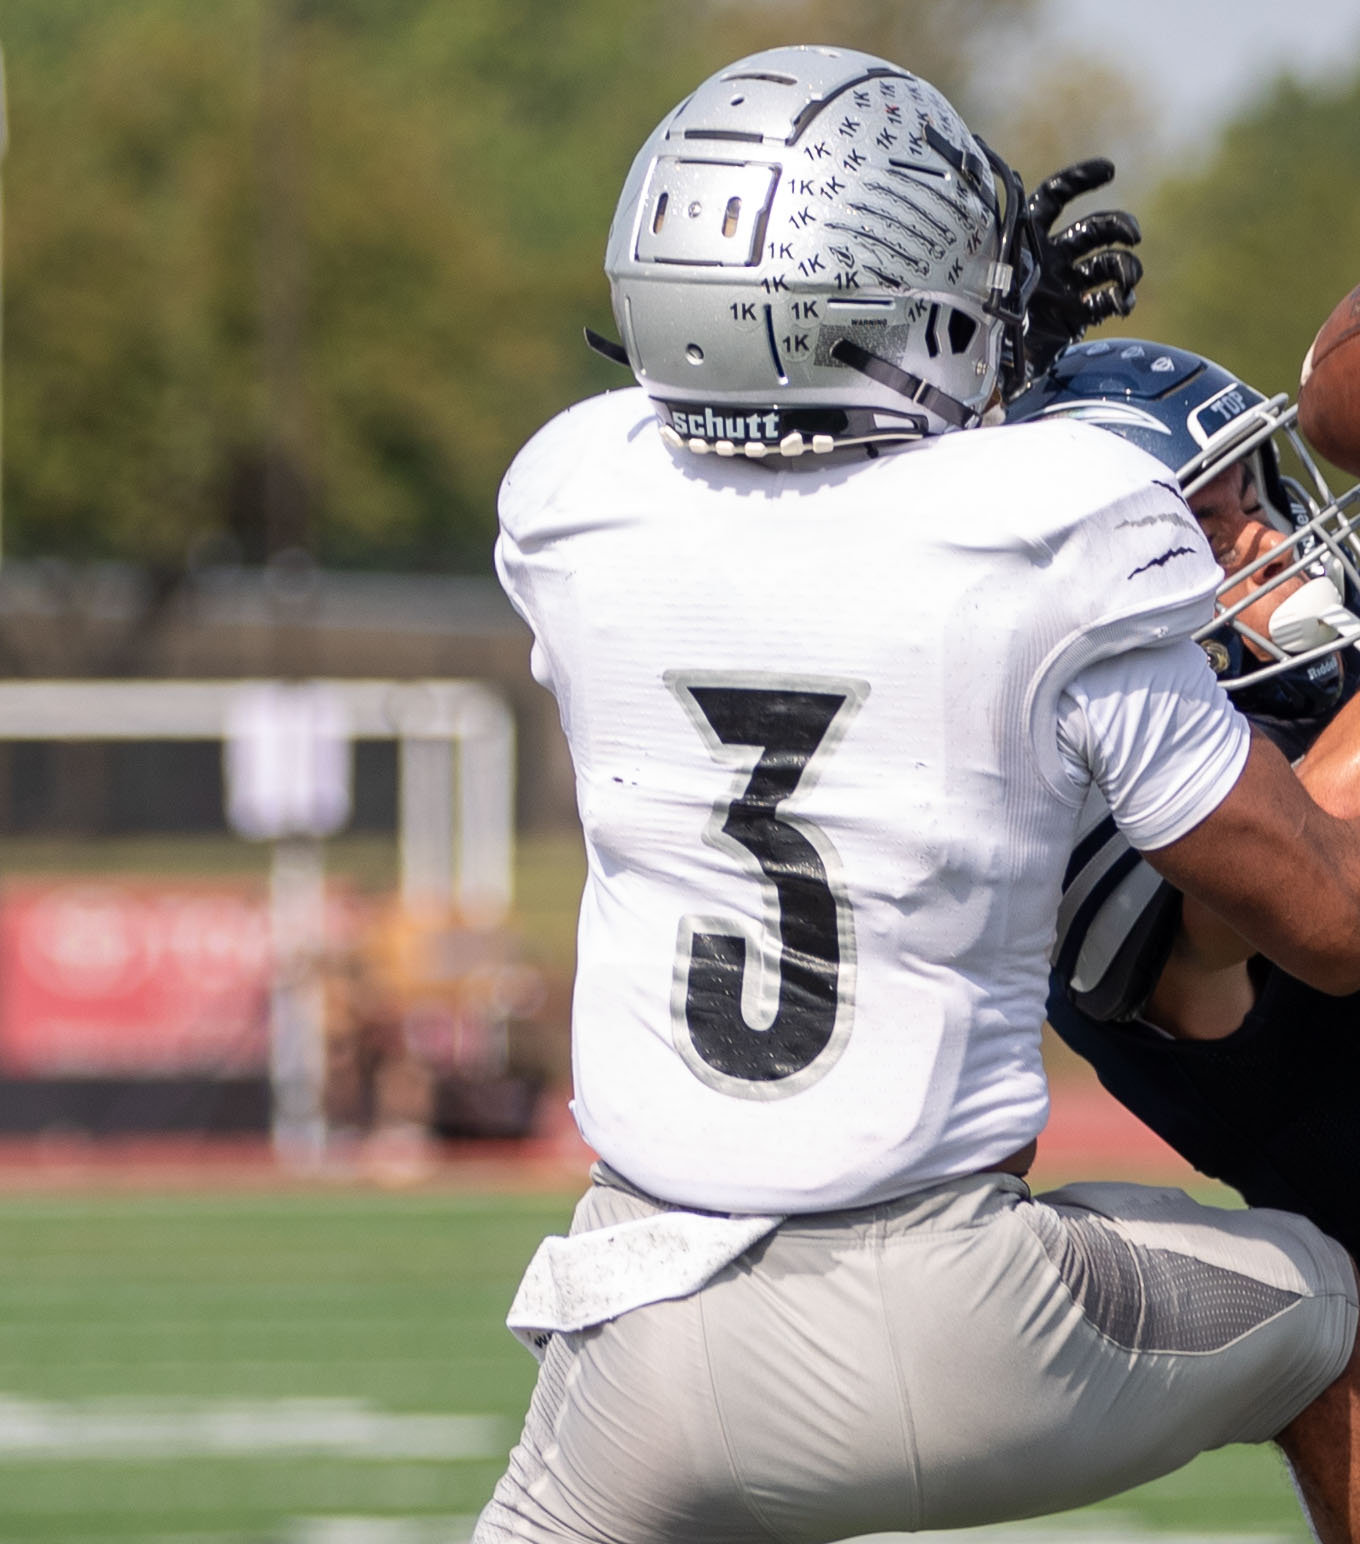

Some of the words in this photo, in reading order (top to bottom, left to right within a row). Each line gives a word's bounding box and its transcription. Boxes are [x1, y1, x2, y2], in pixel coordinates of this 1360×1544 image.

[853, 90, 871, 108] 1K
[885, 103, 902, 125] 1K
[839, 116, 860, 138] 1K
[876, 128, 897, 150] 1K
[909, 132, 925, 156] 1K
[804, 141, 831, 161] 1K
[843, 148, 866, 171] 1K
[788, 179, 814, 196] 1K
[820, 176, 845, 200] 1K
[789, 206, 816, 229] 1K
[768, 242, 794, 260] 1K
[798, 253, 825, 277] 1K
[948, 257, 964, 285] 1K
[761, 274, 790, 295] 1K
[834, 271, 860, 290] 1K
[730, 302, 757, 321] 1K
[791, 301, 819, 320] 1K
[908, 298, 928, 322] 1K
[783, 334, 810, 353] 1K
[1210, 391, 1246, 420] TOP
[672, 407, 780, 440] schutt
[662, 669, 872, 1101] 3
